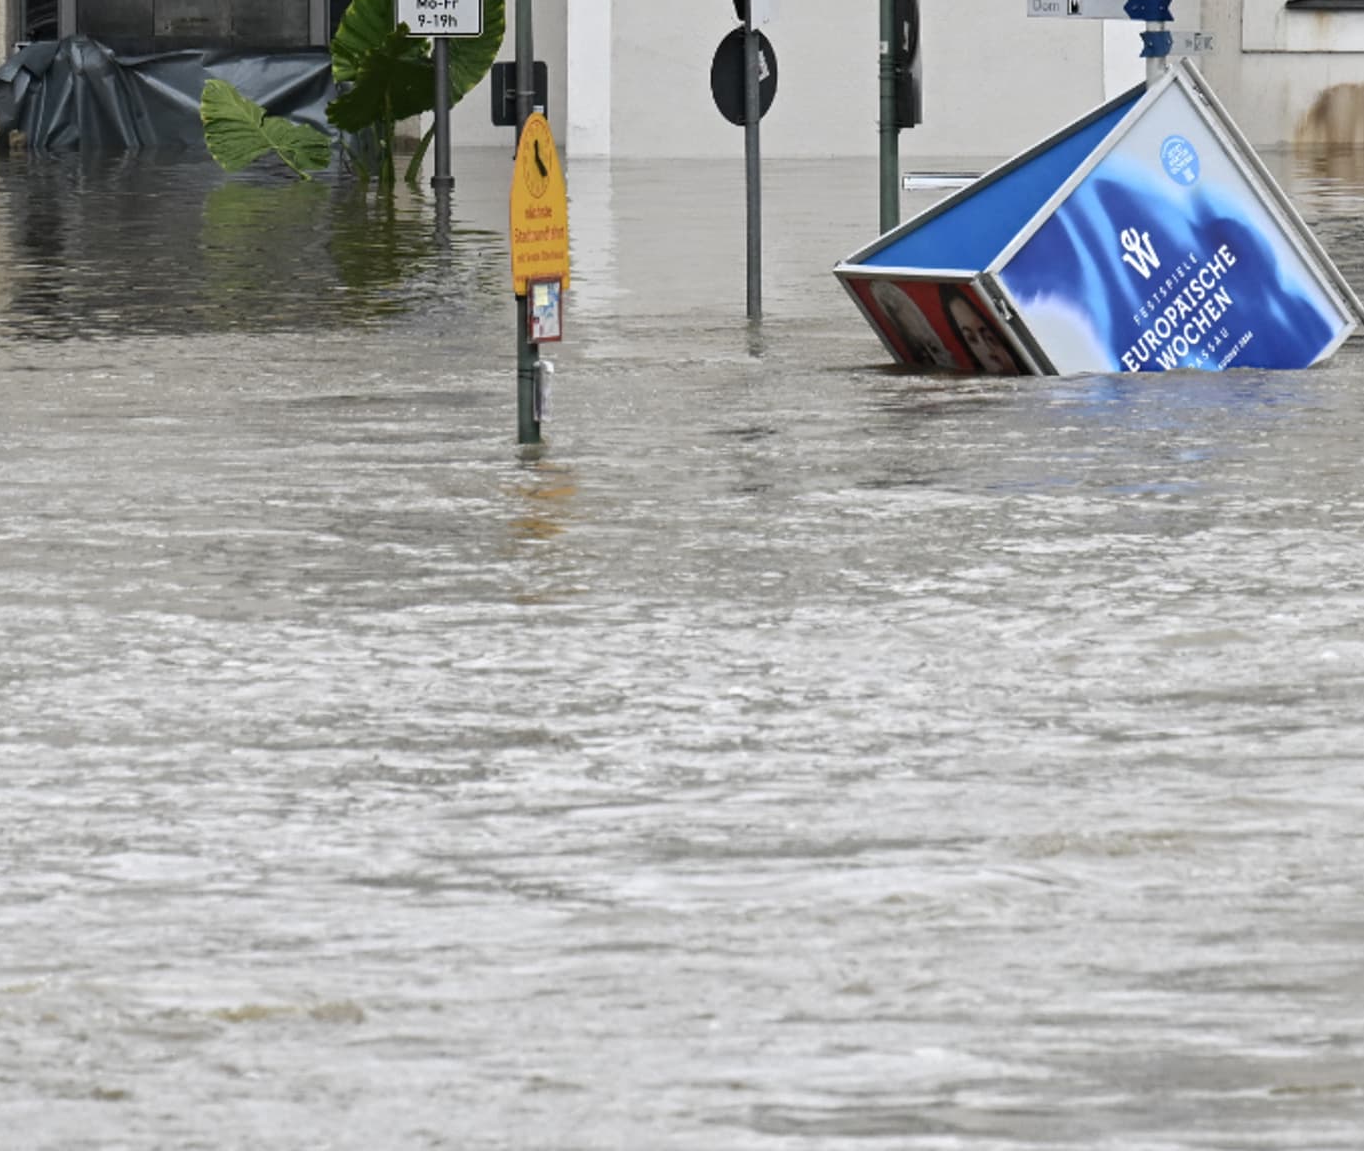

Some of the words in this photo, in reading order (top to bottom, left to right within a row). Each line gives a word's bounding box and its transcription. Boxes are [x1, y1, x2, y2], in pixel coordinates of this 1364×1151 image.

[1121, 244, 1238, 372] EUROPÄISCHE
[1133, 251, 1198, 328] FESTSPIELE
[1155, 285, 1234, 371] WOCHEN
